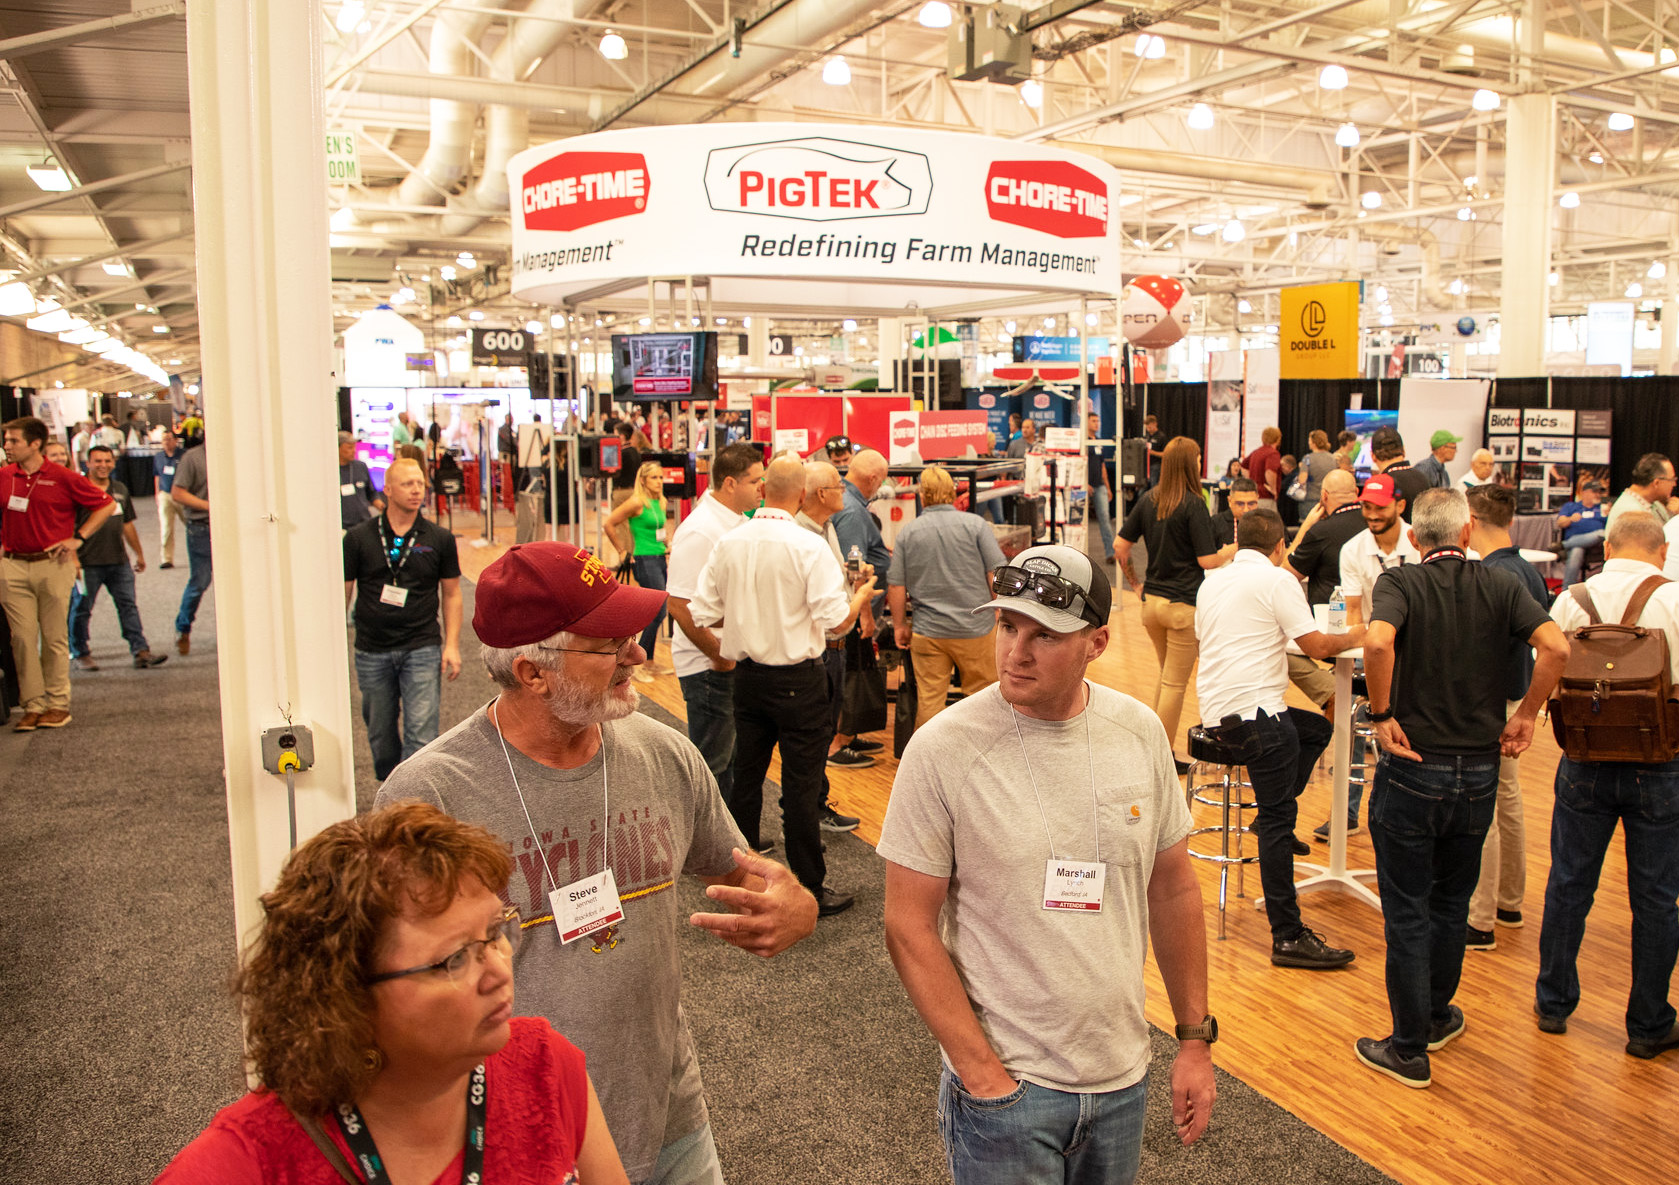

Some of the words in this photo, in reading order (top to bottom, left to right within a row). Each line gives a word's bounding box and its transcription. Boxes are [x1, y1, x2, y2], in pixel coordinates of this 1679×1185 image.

[325, 135, 353, 154] EN'S
[328, 160, 357, 178] OOM
[523, 168, 646, 215] CHORE-TIME
[990, 176, 1107, 222] CHORE-TIME
[741, 233, 896, 264] Redefining
[906, 238, 972, 263] Farm
[980, 242, 1097, 275] Management
[482, 331, 524, 351] 600
[1290, 339, 1328, 351] DOUBLE
[1330, 338, 1336, 349] L
[1418, 359, 1439, 373] 100
[920, 425, 935, 440] CHAIN
[508, 826, 570, 855] IOWA
[590, 807, 650, 832] STATE
[1056, 867, 1096, 879] Marshall
[569, 884, 598, 903] Steve
[577, 918, 607, 935] ATTENDEE
[338, 1102, 363, 1136] G36
